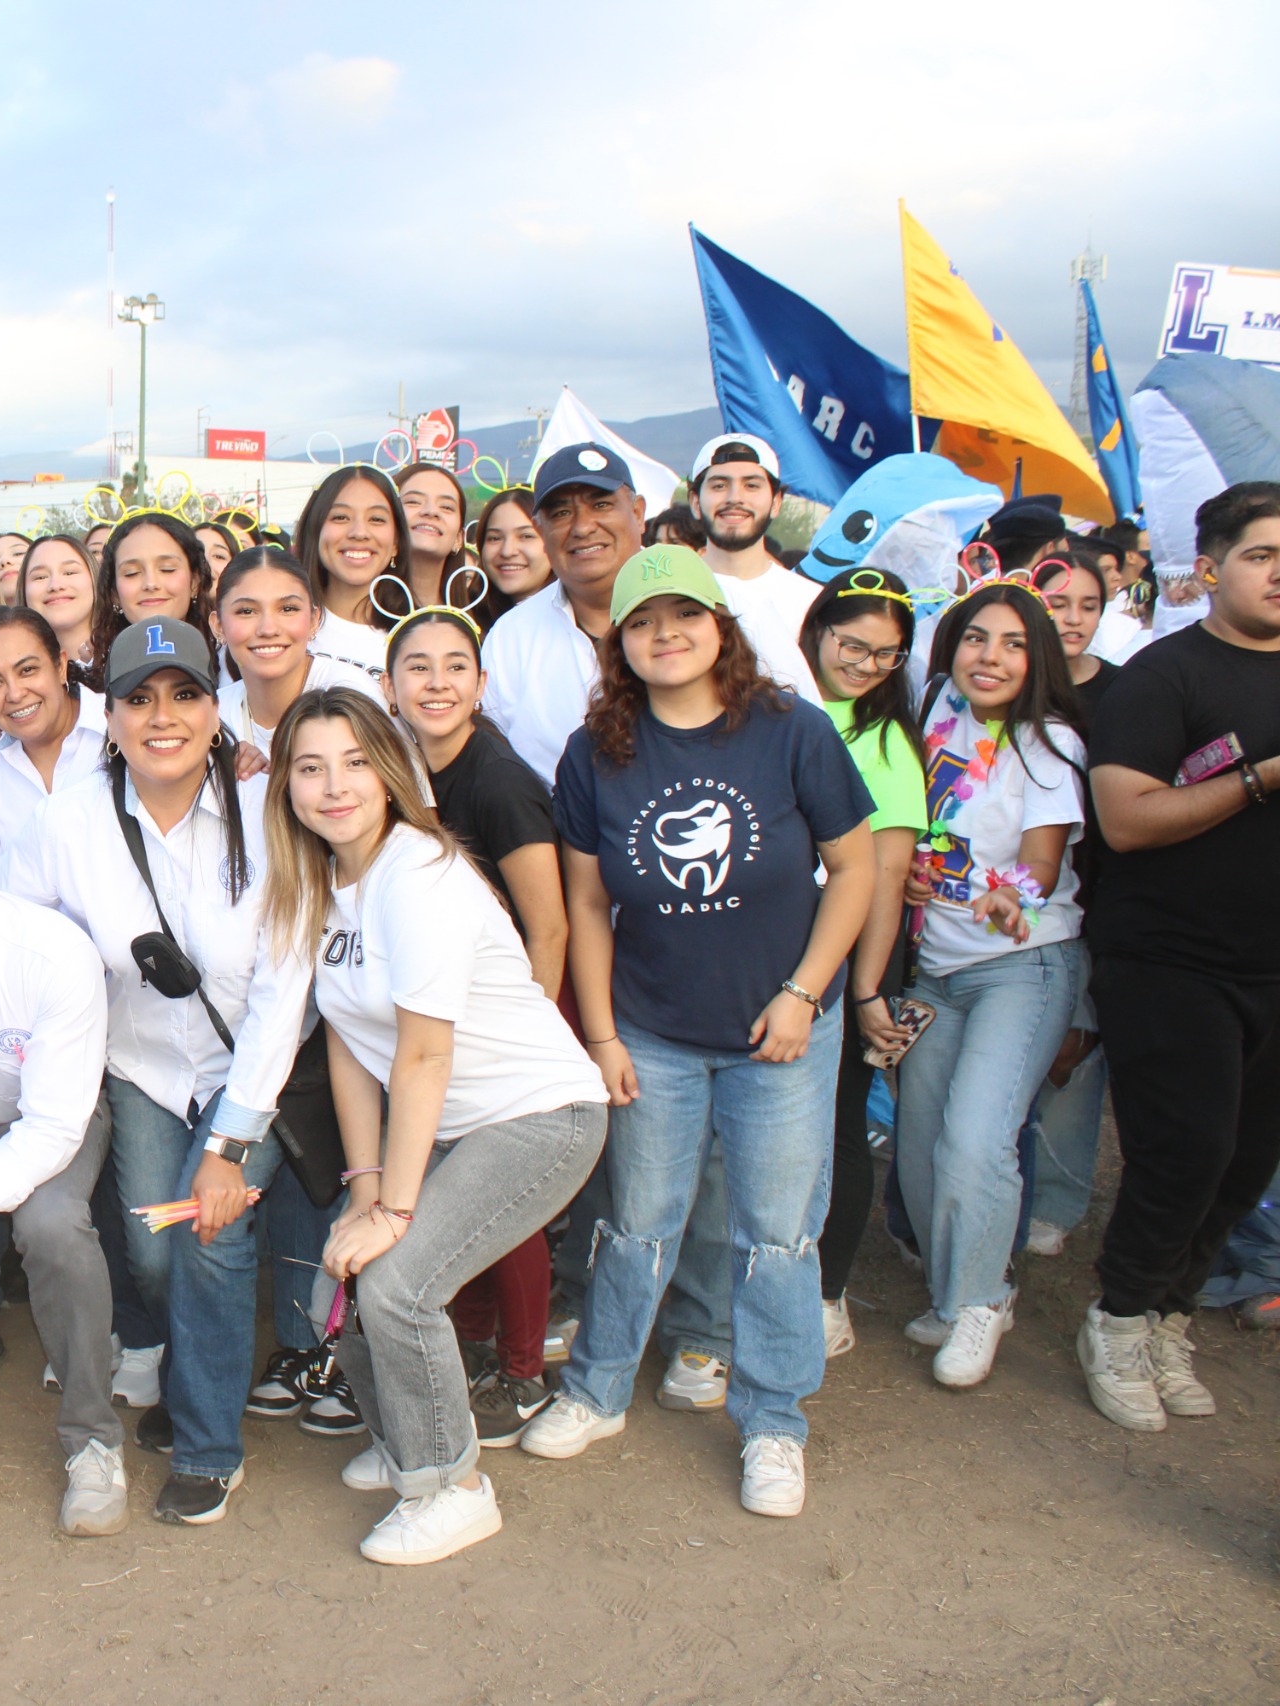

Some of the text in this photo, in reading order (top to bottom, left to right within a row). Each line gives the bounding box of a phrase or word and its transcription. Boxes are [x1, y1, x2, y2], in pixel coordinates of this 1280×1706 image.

[641, 551, 673, 581] NY
[146, 624, 177, 656] L
[627, 799, 658, 877] FACULTAD
[663, 782, 683, 798] DE
